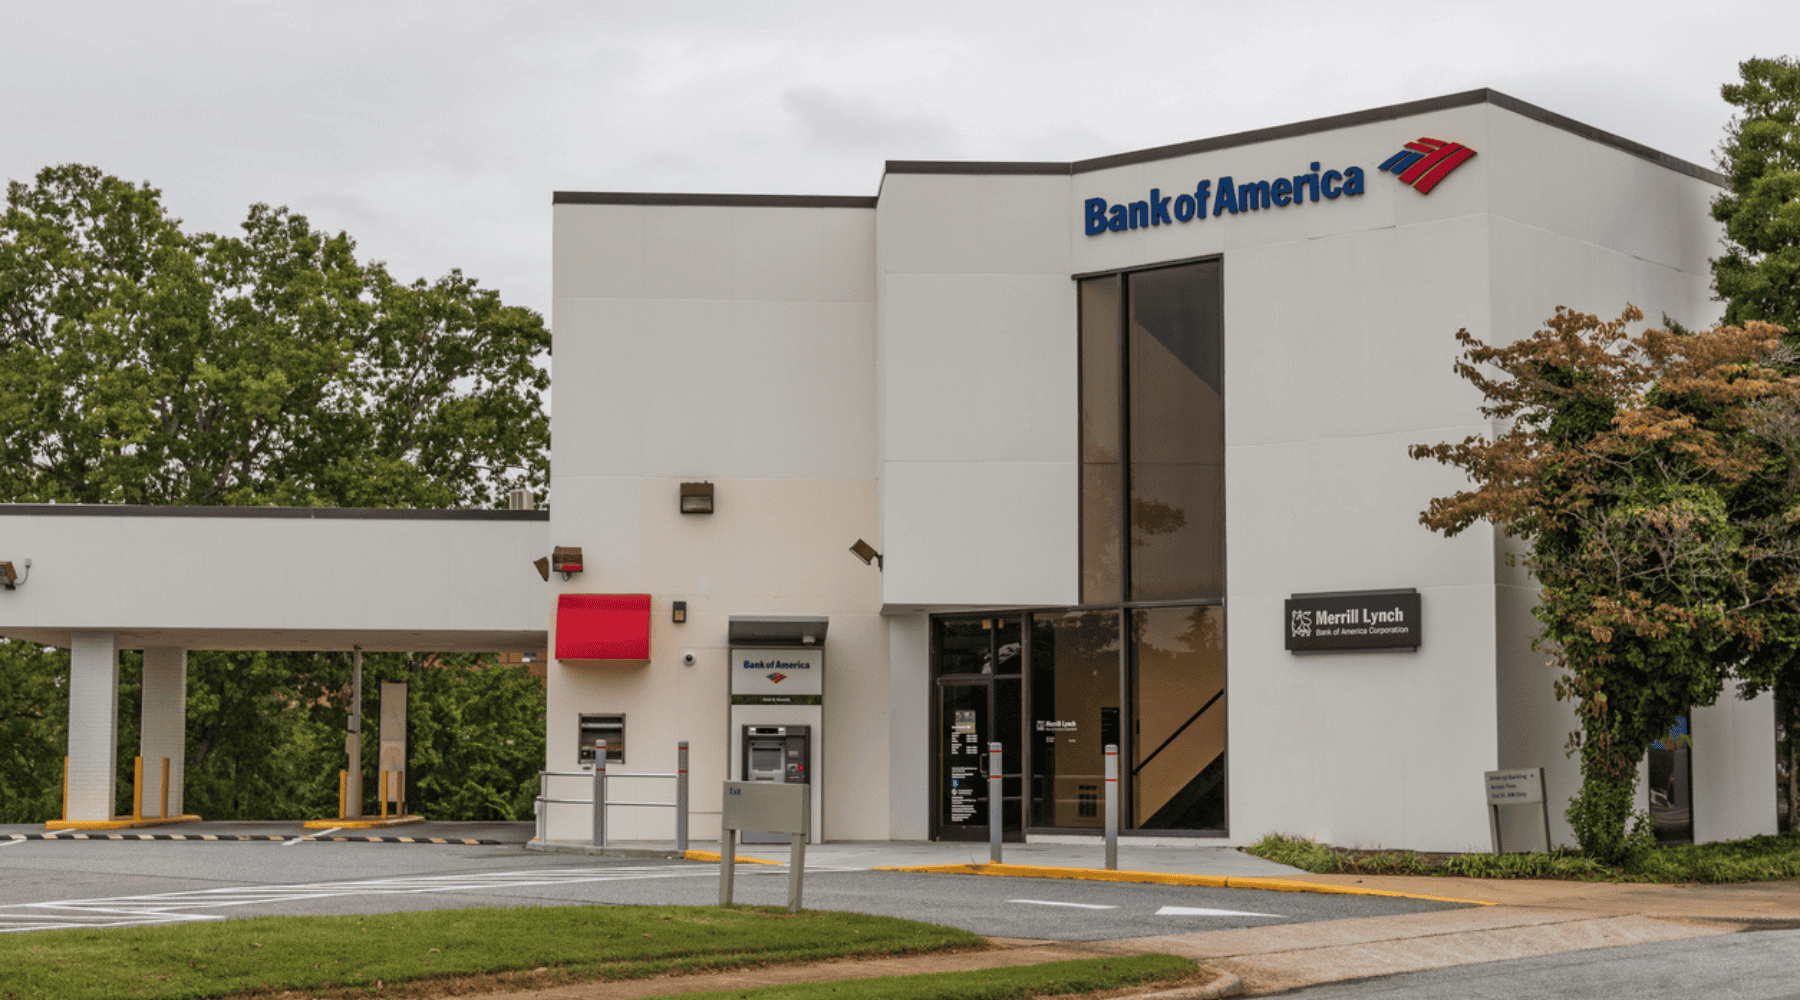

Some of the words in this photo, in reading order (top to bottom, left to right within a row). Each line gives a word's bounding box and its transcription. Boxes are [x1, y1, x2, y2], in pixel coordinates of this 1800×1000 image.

[1085, 188, 1172, 236] Bank
[1174, 179, 1211, 222] of
[1213, 161, 1365, 216] America
[1316, 608, 1358, 625] Merrill
[1363, 607, 1403, 625] Lynch
[1316, 628, 1332, 636] Bank
[1333, 628, 1340, 636] of
[1341, 627, 1367, 636] America
[1368, 626, 1409, 635] Corporation
[743, 660, 765, 669] Bank
[766, 660, 774, 669] of
[775, 660, 811, 669] America
